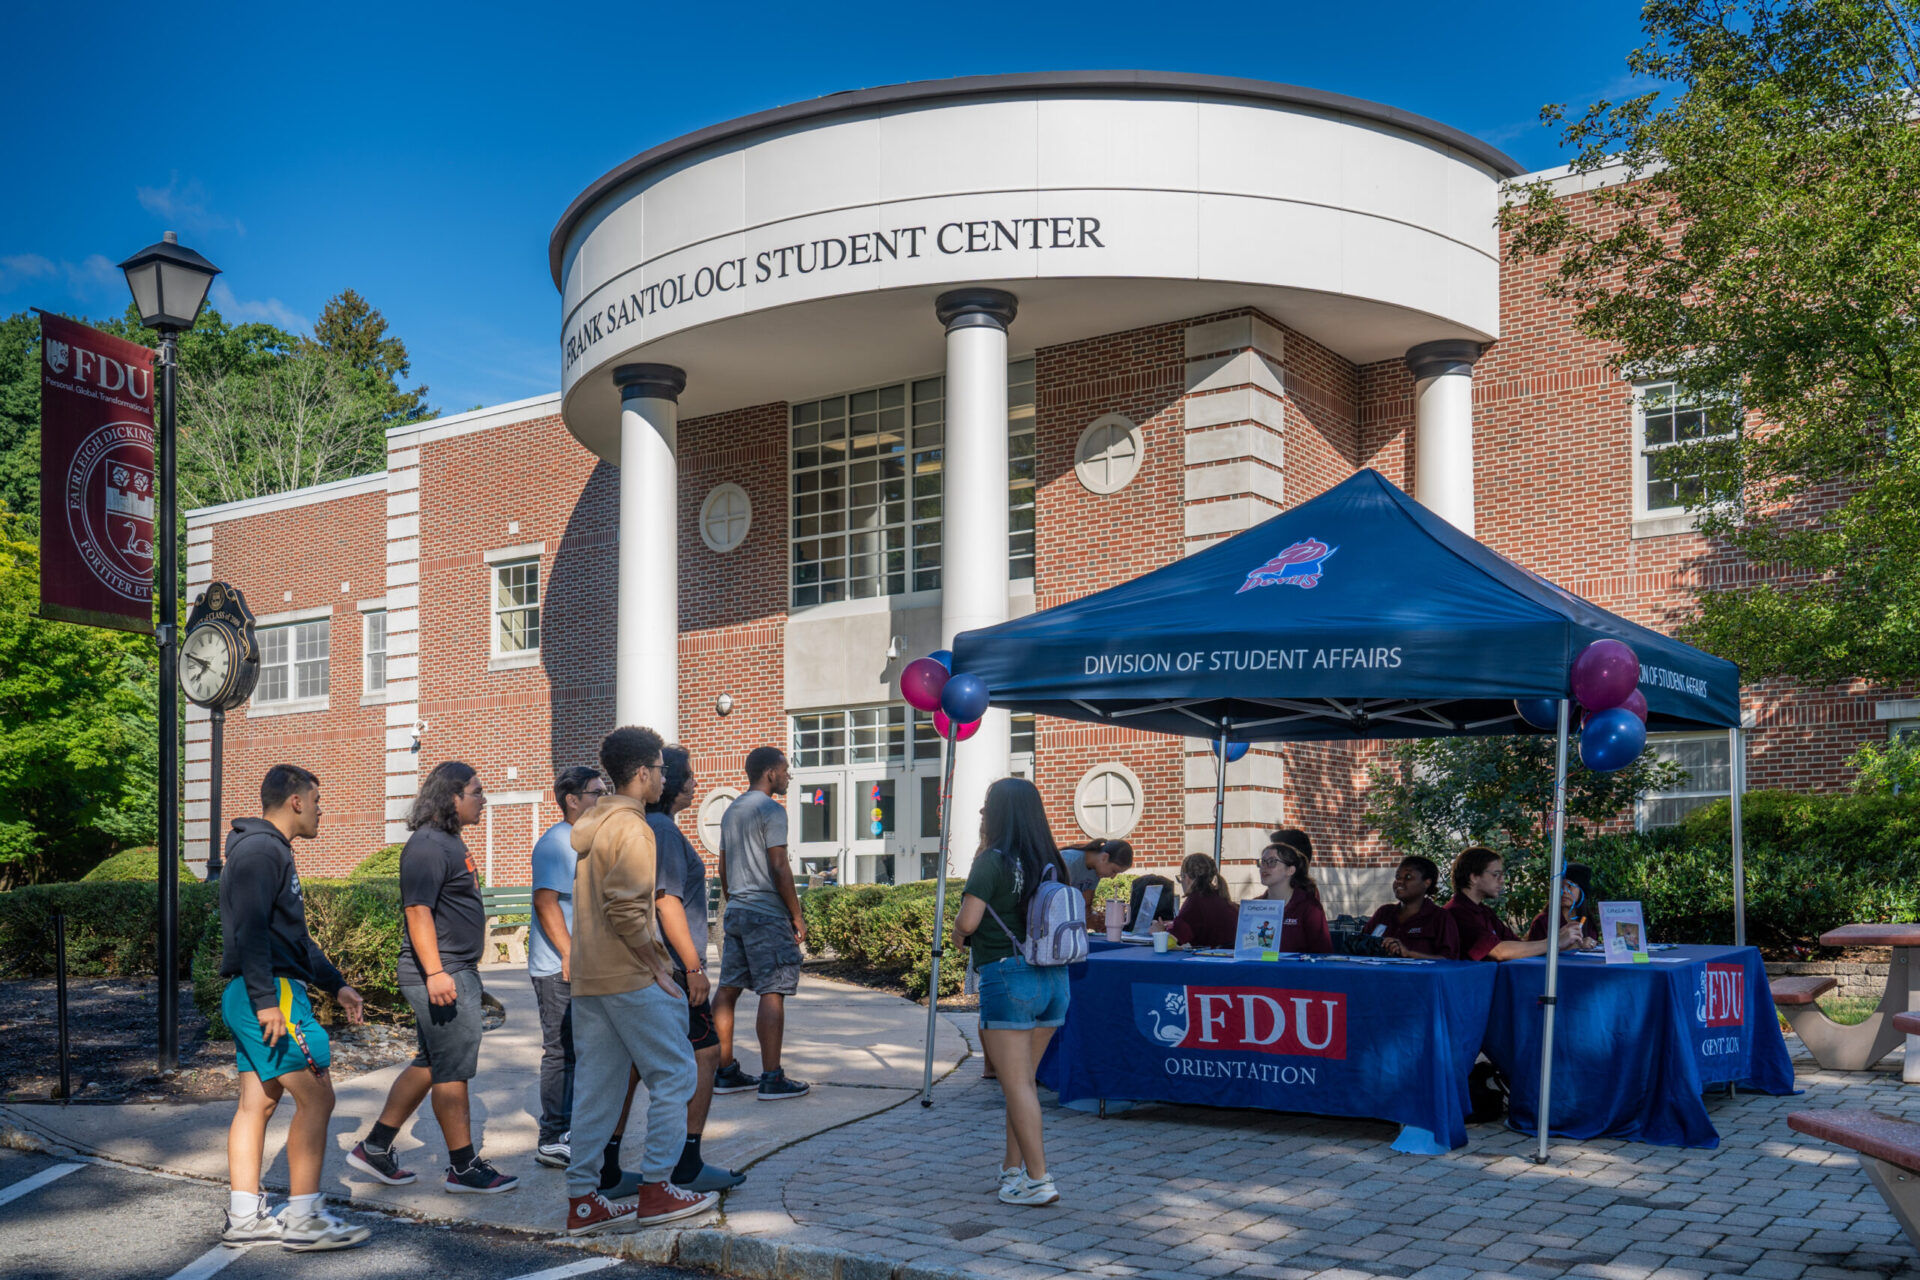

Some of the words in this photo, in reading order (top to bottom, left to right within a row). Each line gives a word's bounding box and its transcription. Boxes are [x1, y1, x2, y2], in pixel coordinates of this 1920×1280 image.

[566, 312, 604, 371] FRANK
[607, 257, 747, 334] SANTOLOCI
[755, 226, 926, 284] STUDENT
[936, 216, 1105, 255] CENTER
[72, 346, 150, 400] FDU
[70, 436, 104, 509] FAIRLEIGH
[102, 426, 154, 444] DICKINS
[80, 540, 132, 594] FORTITER
[135, 586, 149, 597] ET
[1084, 653, 1171, 675] DIVISION
[1176, 651, 1205, 672] OF
[1209, 649, 1308, 671] STUDENT
[1312, 647, 1402, 669] AFFAIRS
[1649, 665, 1658, 686] OF
[1658, 667, 1686, 692] STUDENT
[1685, 675, 1707, 698] AFFAIRS
[1194, 993, 1338, 1050] FDU
[1707, 971, 1742, 1020] FDU
[1164, 1057, 1316, 1085] ORIENTATION
